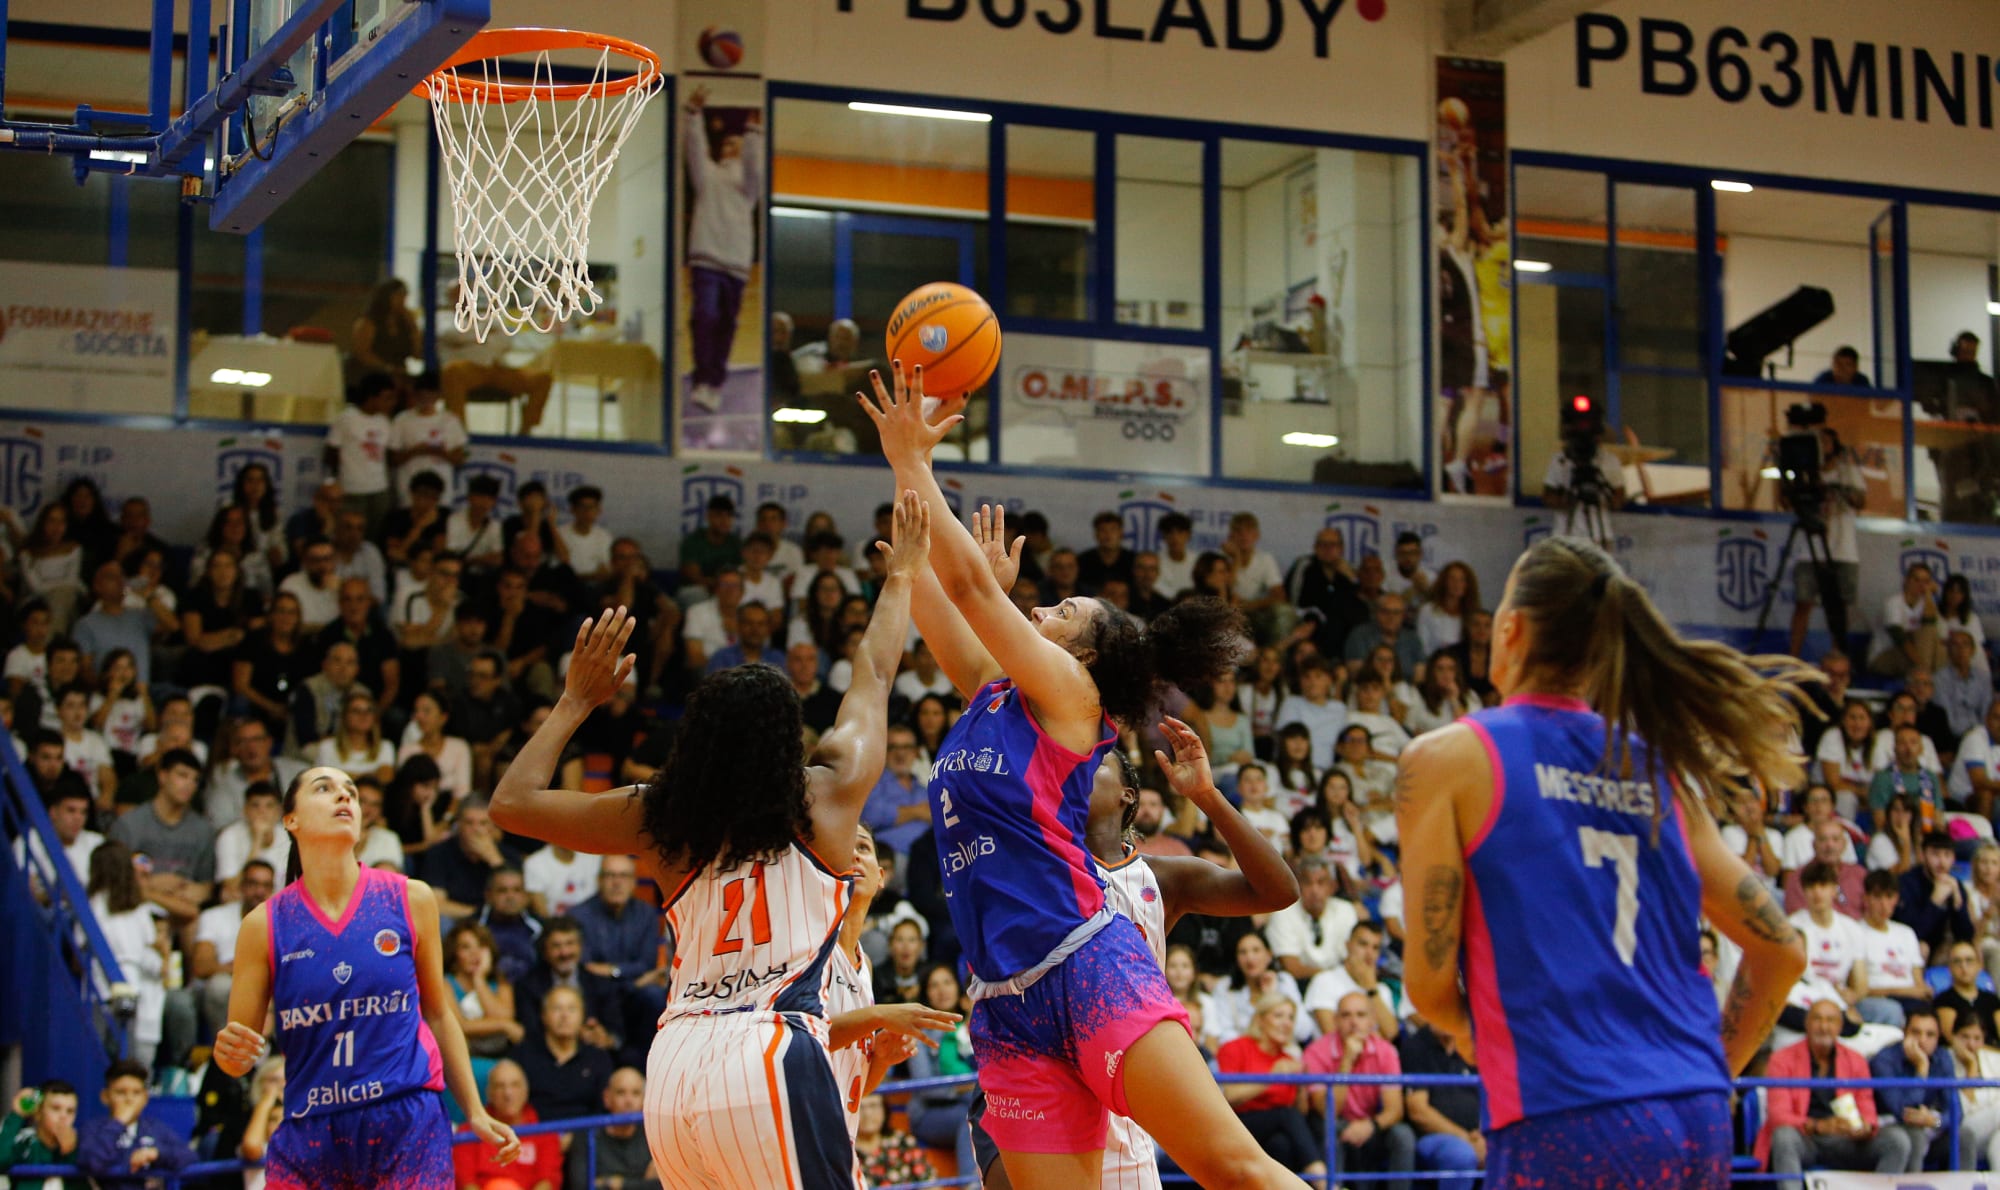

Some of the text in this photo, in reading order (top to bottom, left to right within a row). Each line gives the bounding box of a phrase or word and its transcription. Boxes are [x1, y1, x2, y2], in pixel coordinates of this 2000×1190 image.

[836, 0, 1345, 58] LADY
[1575, 12, 1993, 130] PB63MINI
[940, 787, 960, 829] 2
[1534, 762, 1655, 816] MESTRES
[712, 857, 772, 957] 21
[1577, 825, 1640, 968] 7
[280, 1002, 333, 1031] BAXI
[332, 1030, 354, 1067] 11
[291, 1080, 384, 1118] galicia
[999, 1107, 1045, 1121] GALICIA
